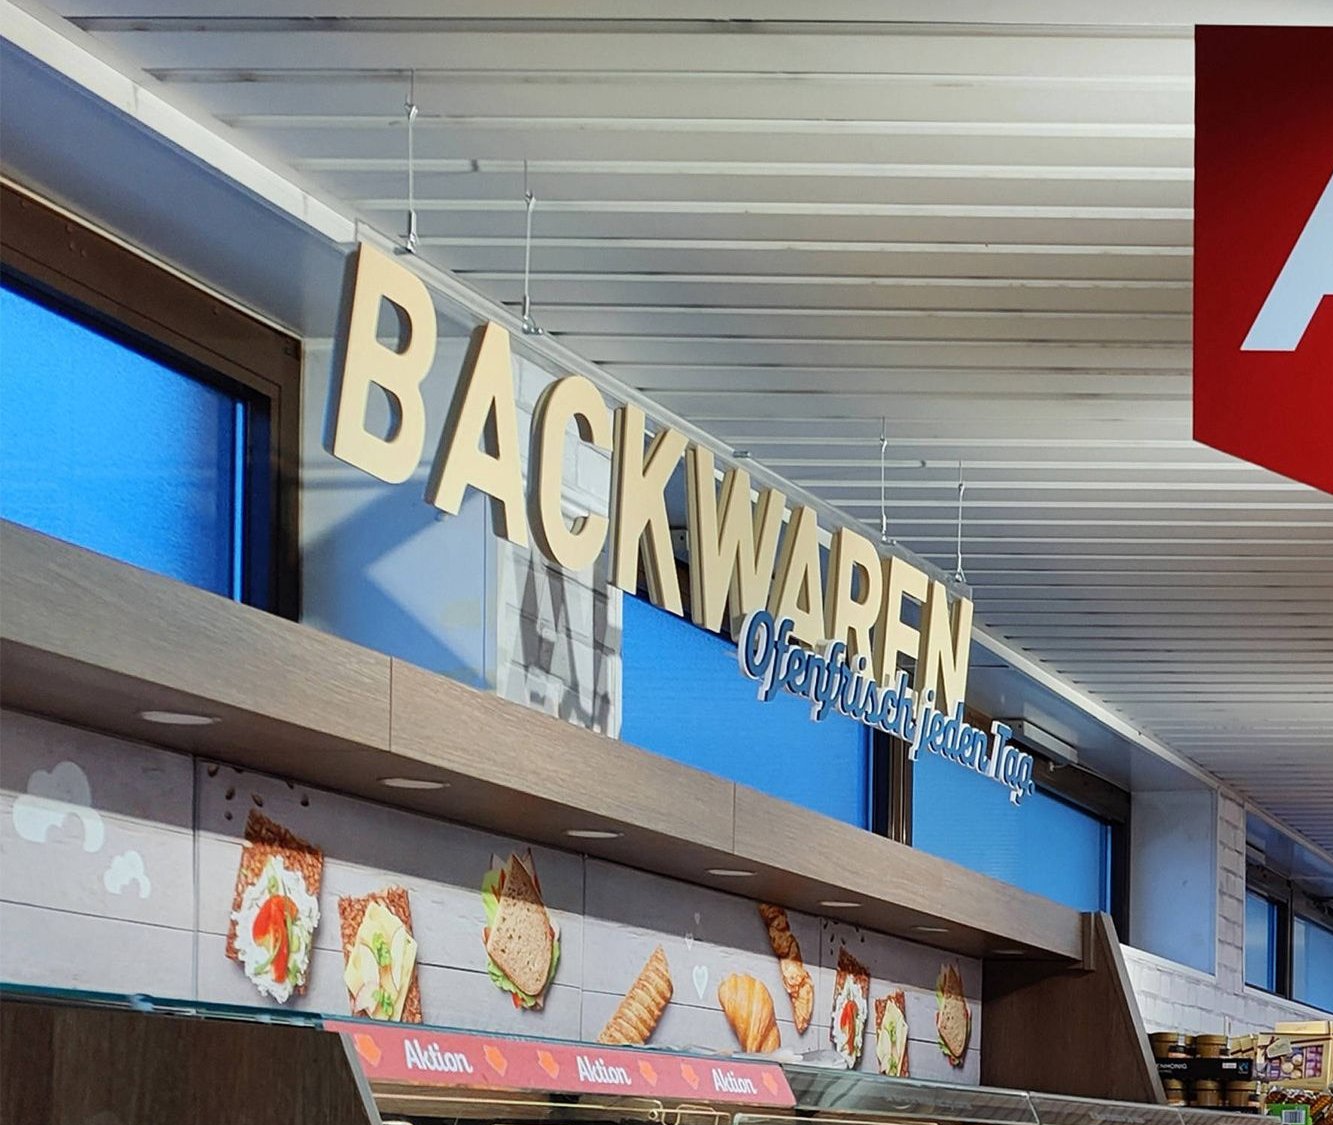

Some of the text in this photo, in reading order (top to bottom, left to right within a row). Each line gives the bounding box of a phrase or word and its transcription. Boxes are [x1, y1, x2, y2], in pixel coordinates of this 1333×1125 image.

[328, 242, 974, 712] BACKWAREN
[739, 608, 915, 743] Ofenfrisch
[909, 687, 990, 776] jeden
[405, 1038, 473, 1074] Aktion
[577, 1056, 632, 1086] Aktion
[712, 1068, 758, 1096] Aktion
